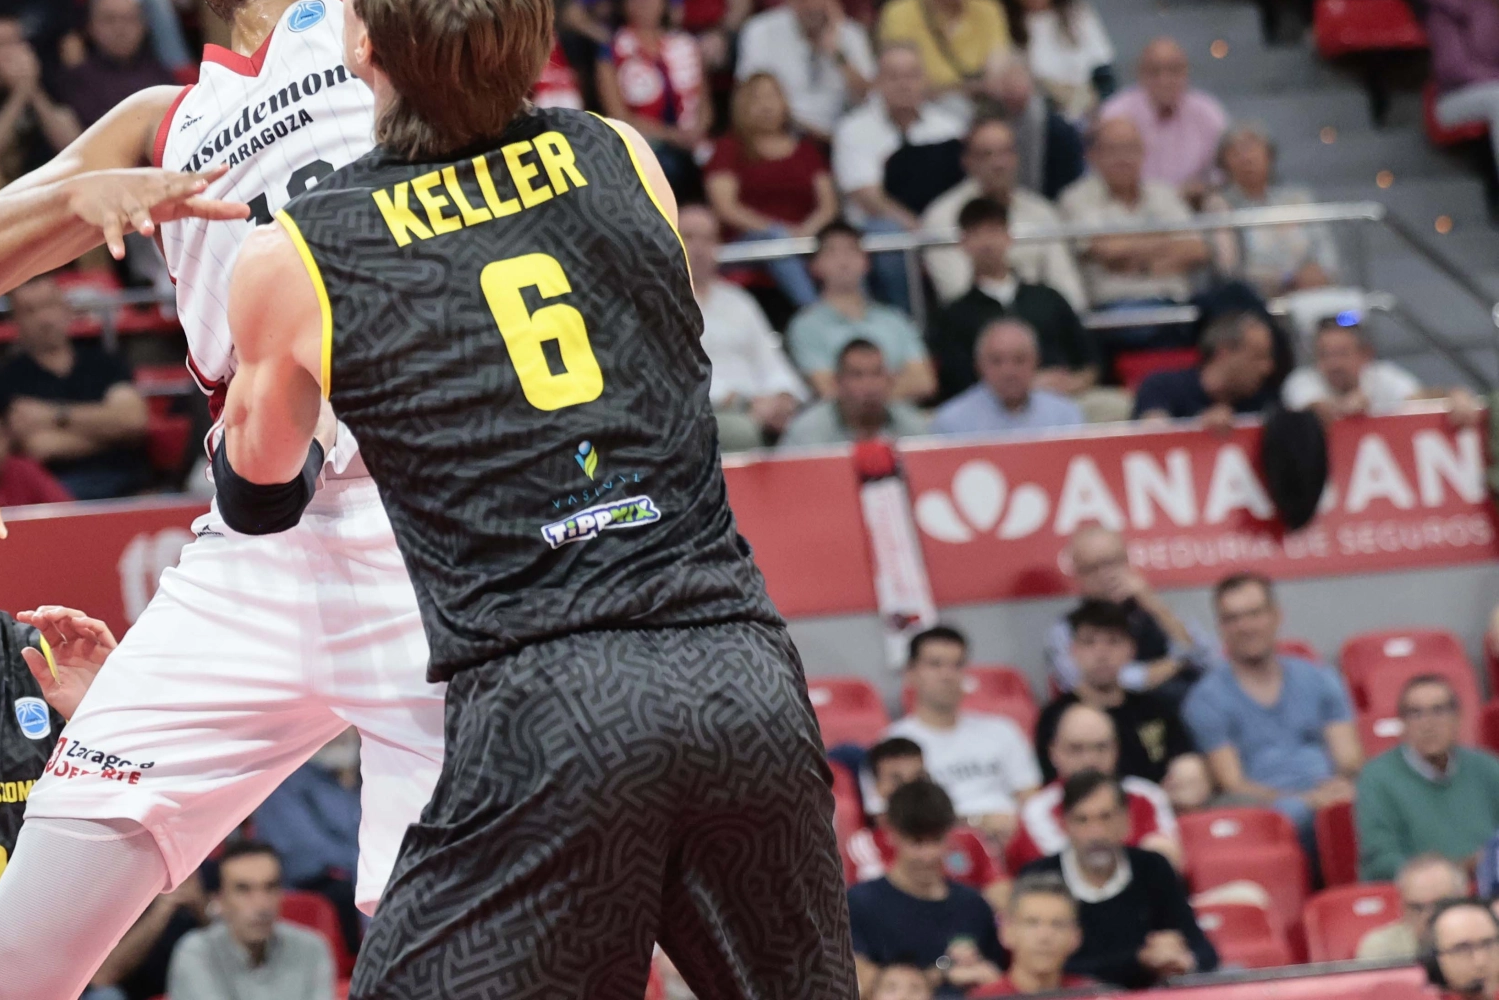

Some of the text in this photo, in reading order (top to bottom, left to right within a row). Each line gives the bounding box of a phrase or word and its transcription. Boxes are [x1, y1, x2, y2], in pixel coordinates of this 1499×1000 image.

[181, 65, 360, 173] asademon
[372, 131, 588, 248] KELLER
[480, 253, 604, 411] 6
[1054, 427, 1487, 536] ANAAN
[1337, 510, 1493, 557] SEGUROS
[54, 761, 141, 785] DERTE
[67, 740, 154, 770] Zaraga
